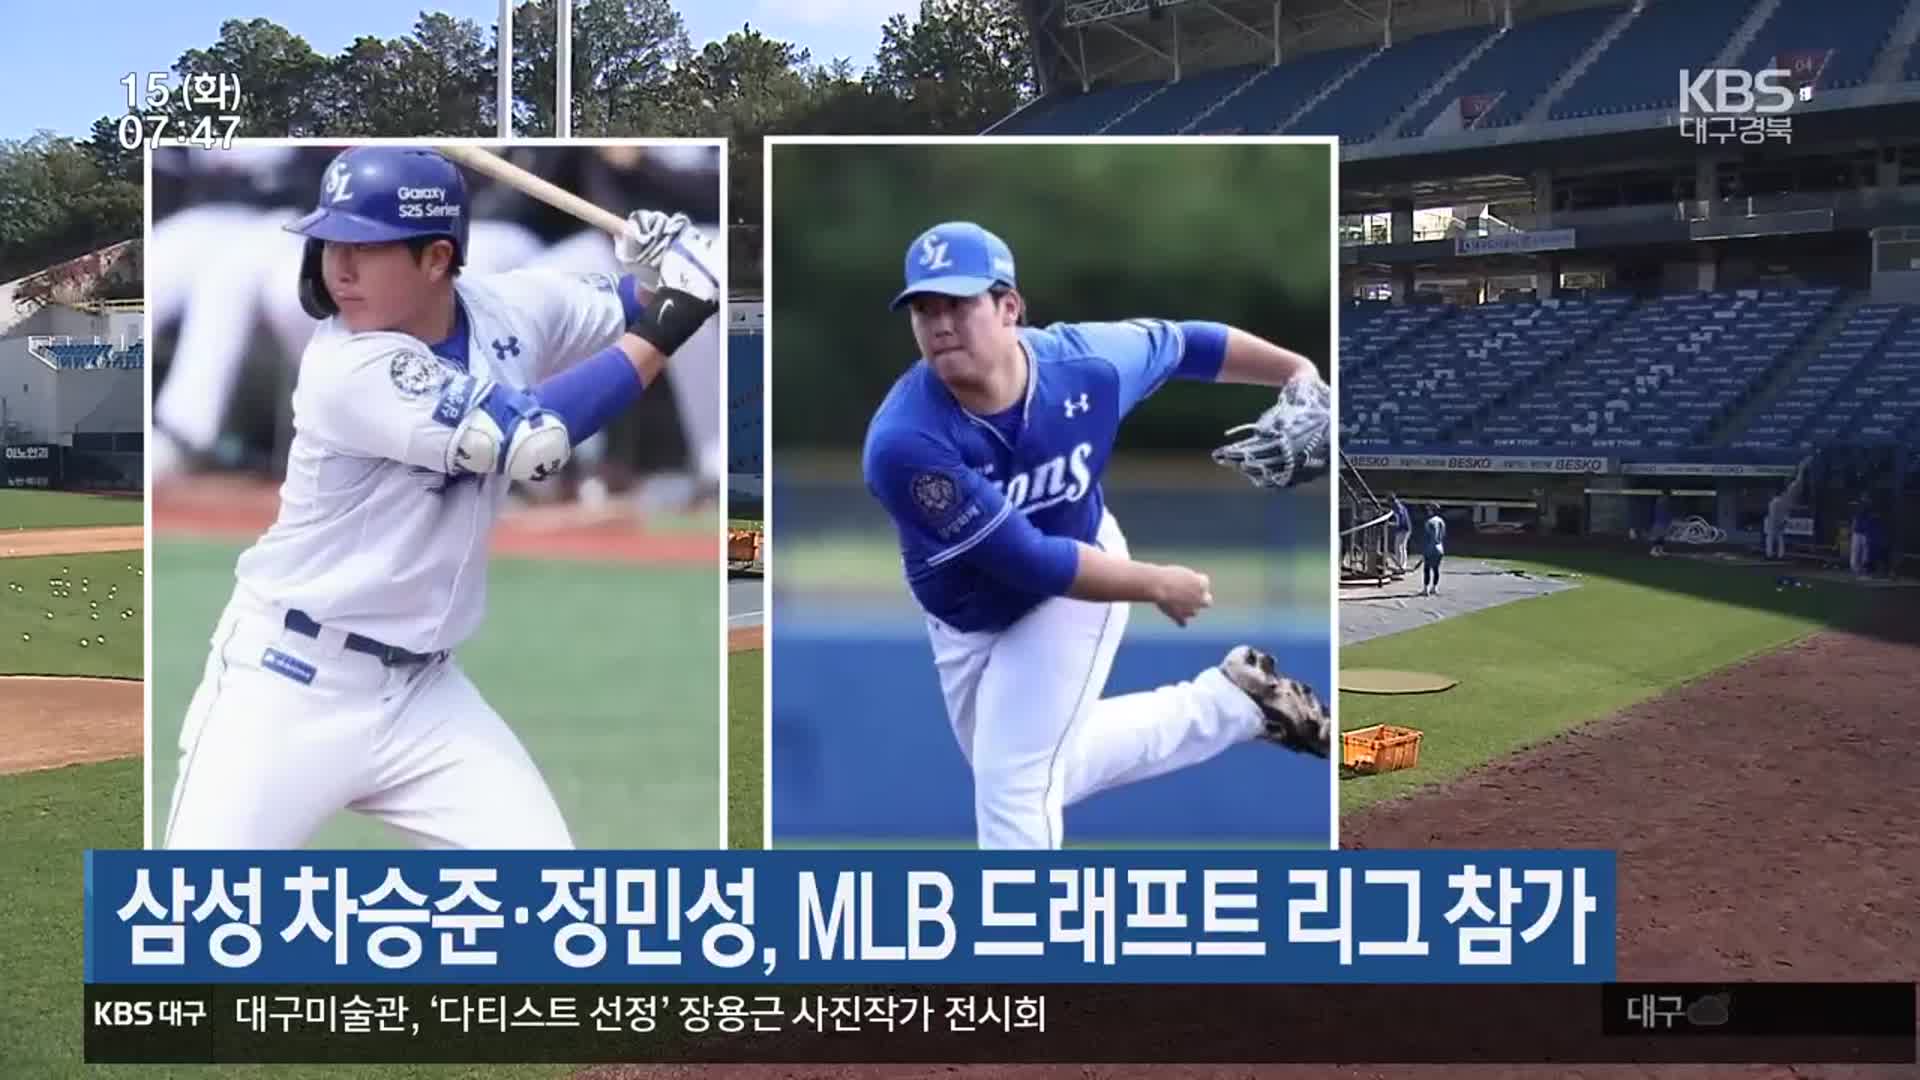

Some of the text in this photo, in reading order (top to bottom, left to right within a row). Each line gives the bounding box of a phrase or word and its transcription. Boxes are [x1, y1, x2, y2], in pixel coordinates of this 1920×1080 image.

[398, 186, 446, 202] Galaxy
[399, 203, 461, 218] S25 Series
[1448, 456, 1492, 469] BESKO
[1555, 457, 1601, 471] BESKO
